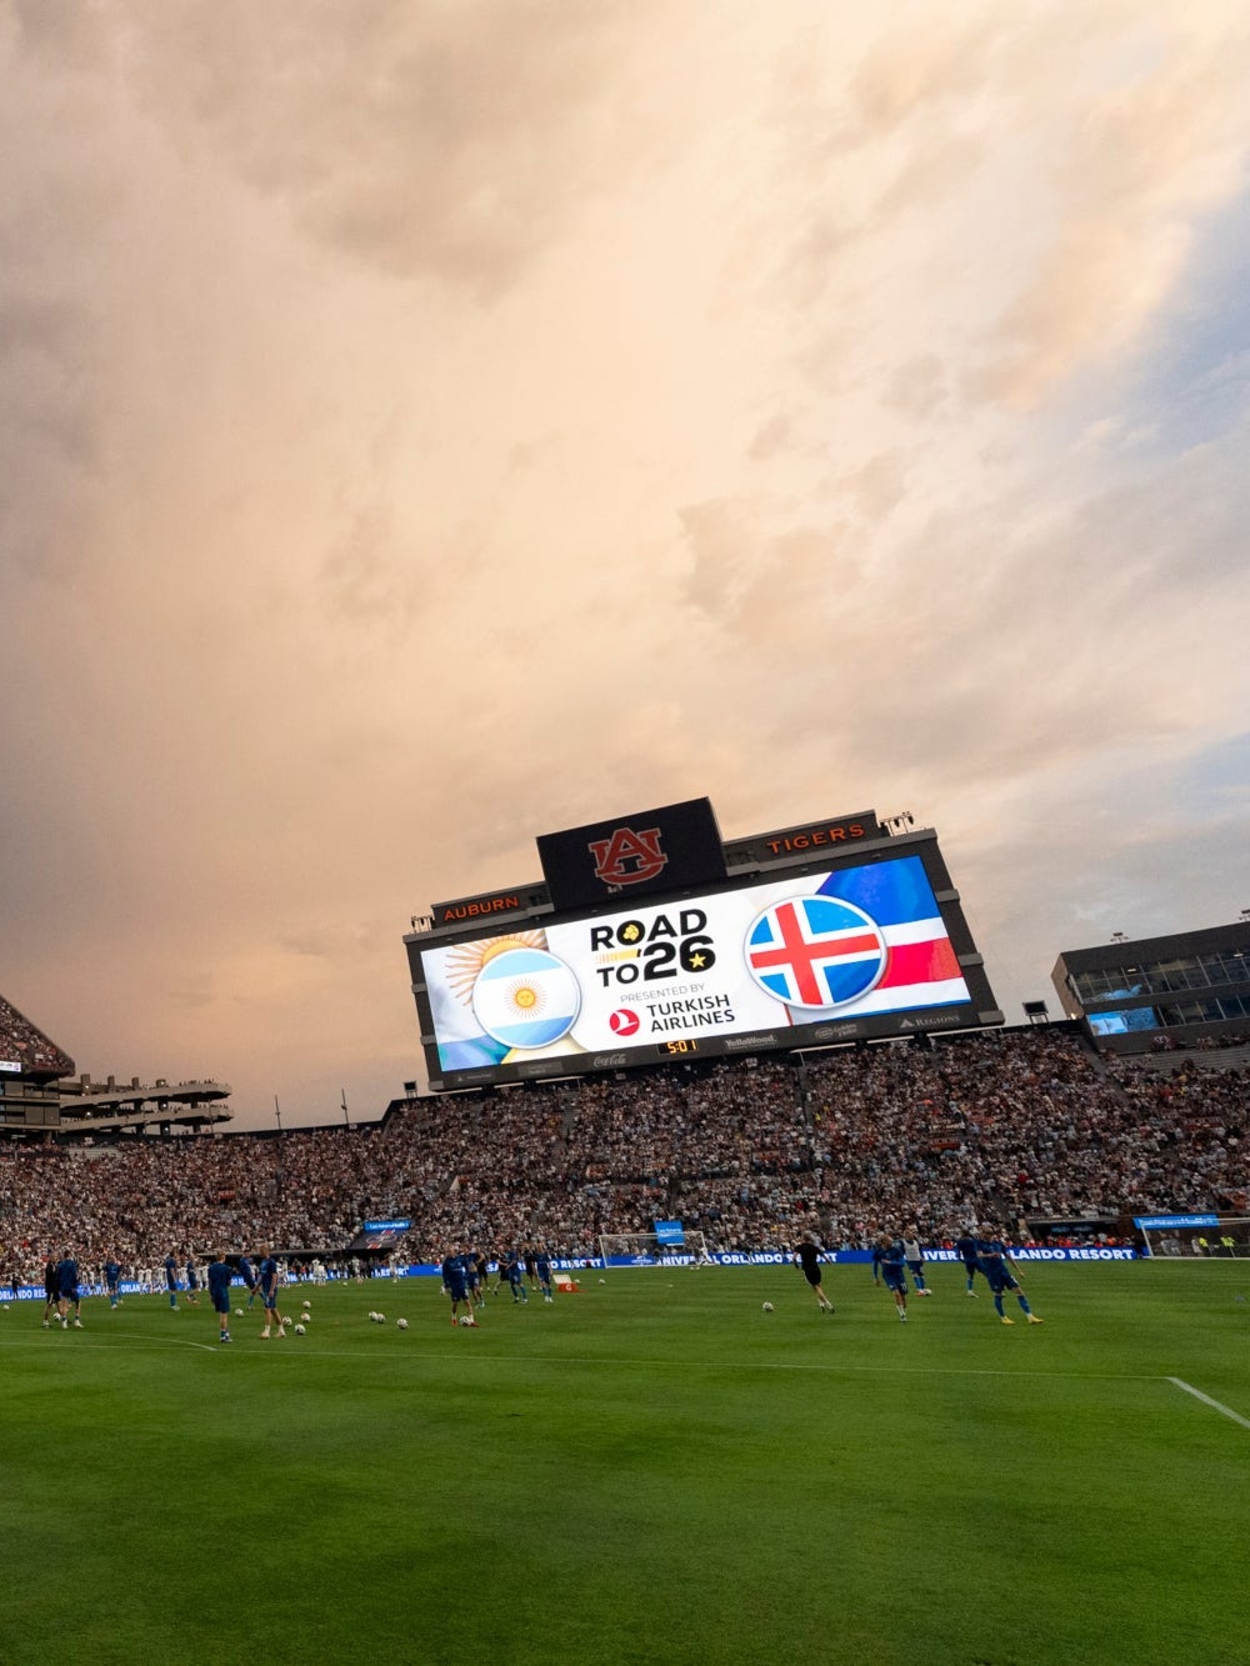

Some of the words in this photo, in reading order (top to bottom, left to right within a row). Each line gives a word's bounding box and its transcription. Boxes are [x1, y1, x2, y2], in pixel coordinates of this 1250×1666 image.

[767, 824, 866, 854] TIGERS
[444, 896, 519, 920] AUBURN
[590, 908, 707, 951] ROAD
[596, 963, 639, 987] TO
[620, 985, 688, 1003] PRESENTED
[690, 983, 705, 994] BY
[646, 994, 730, 1017] TURKISH
[651, 1009, 735, 1033] AIRLINES
[667, 1039, 697, 1054] 5:01
[1001, 1249, 1065, 1260] LANDO
[1070, 1248, 1133, 1260] RESORT
